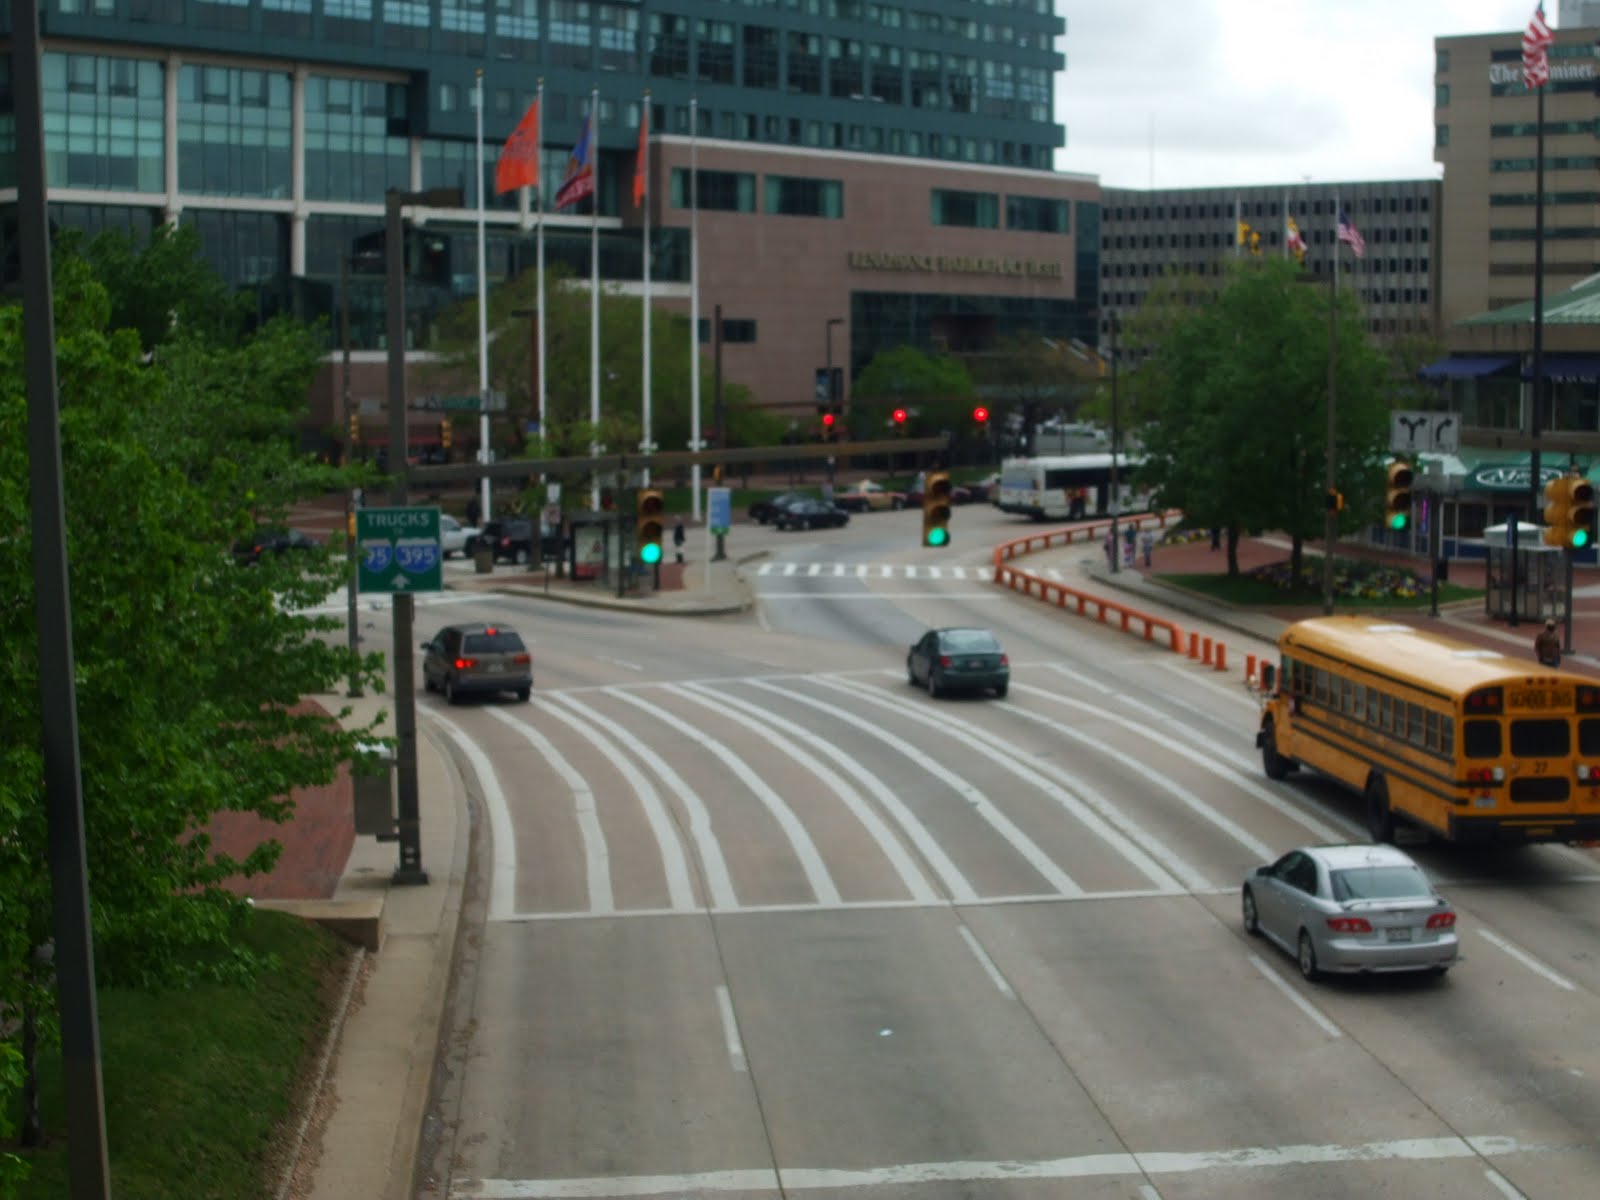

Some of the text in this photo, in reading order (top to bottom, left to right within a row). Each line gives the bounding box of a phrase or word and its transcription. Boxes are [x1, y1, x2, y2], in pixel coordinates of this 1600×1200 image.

[1489, 63, 1519, 84] The
[367, 512, 430, 527] TRUCKS
[401, 546, 434, 566] 395
